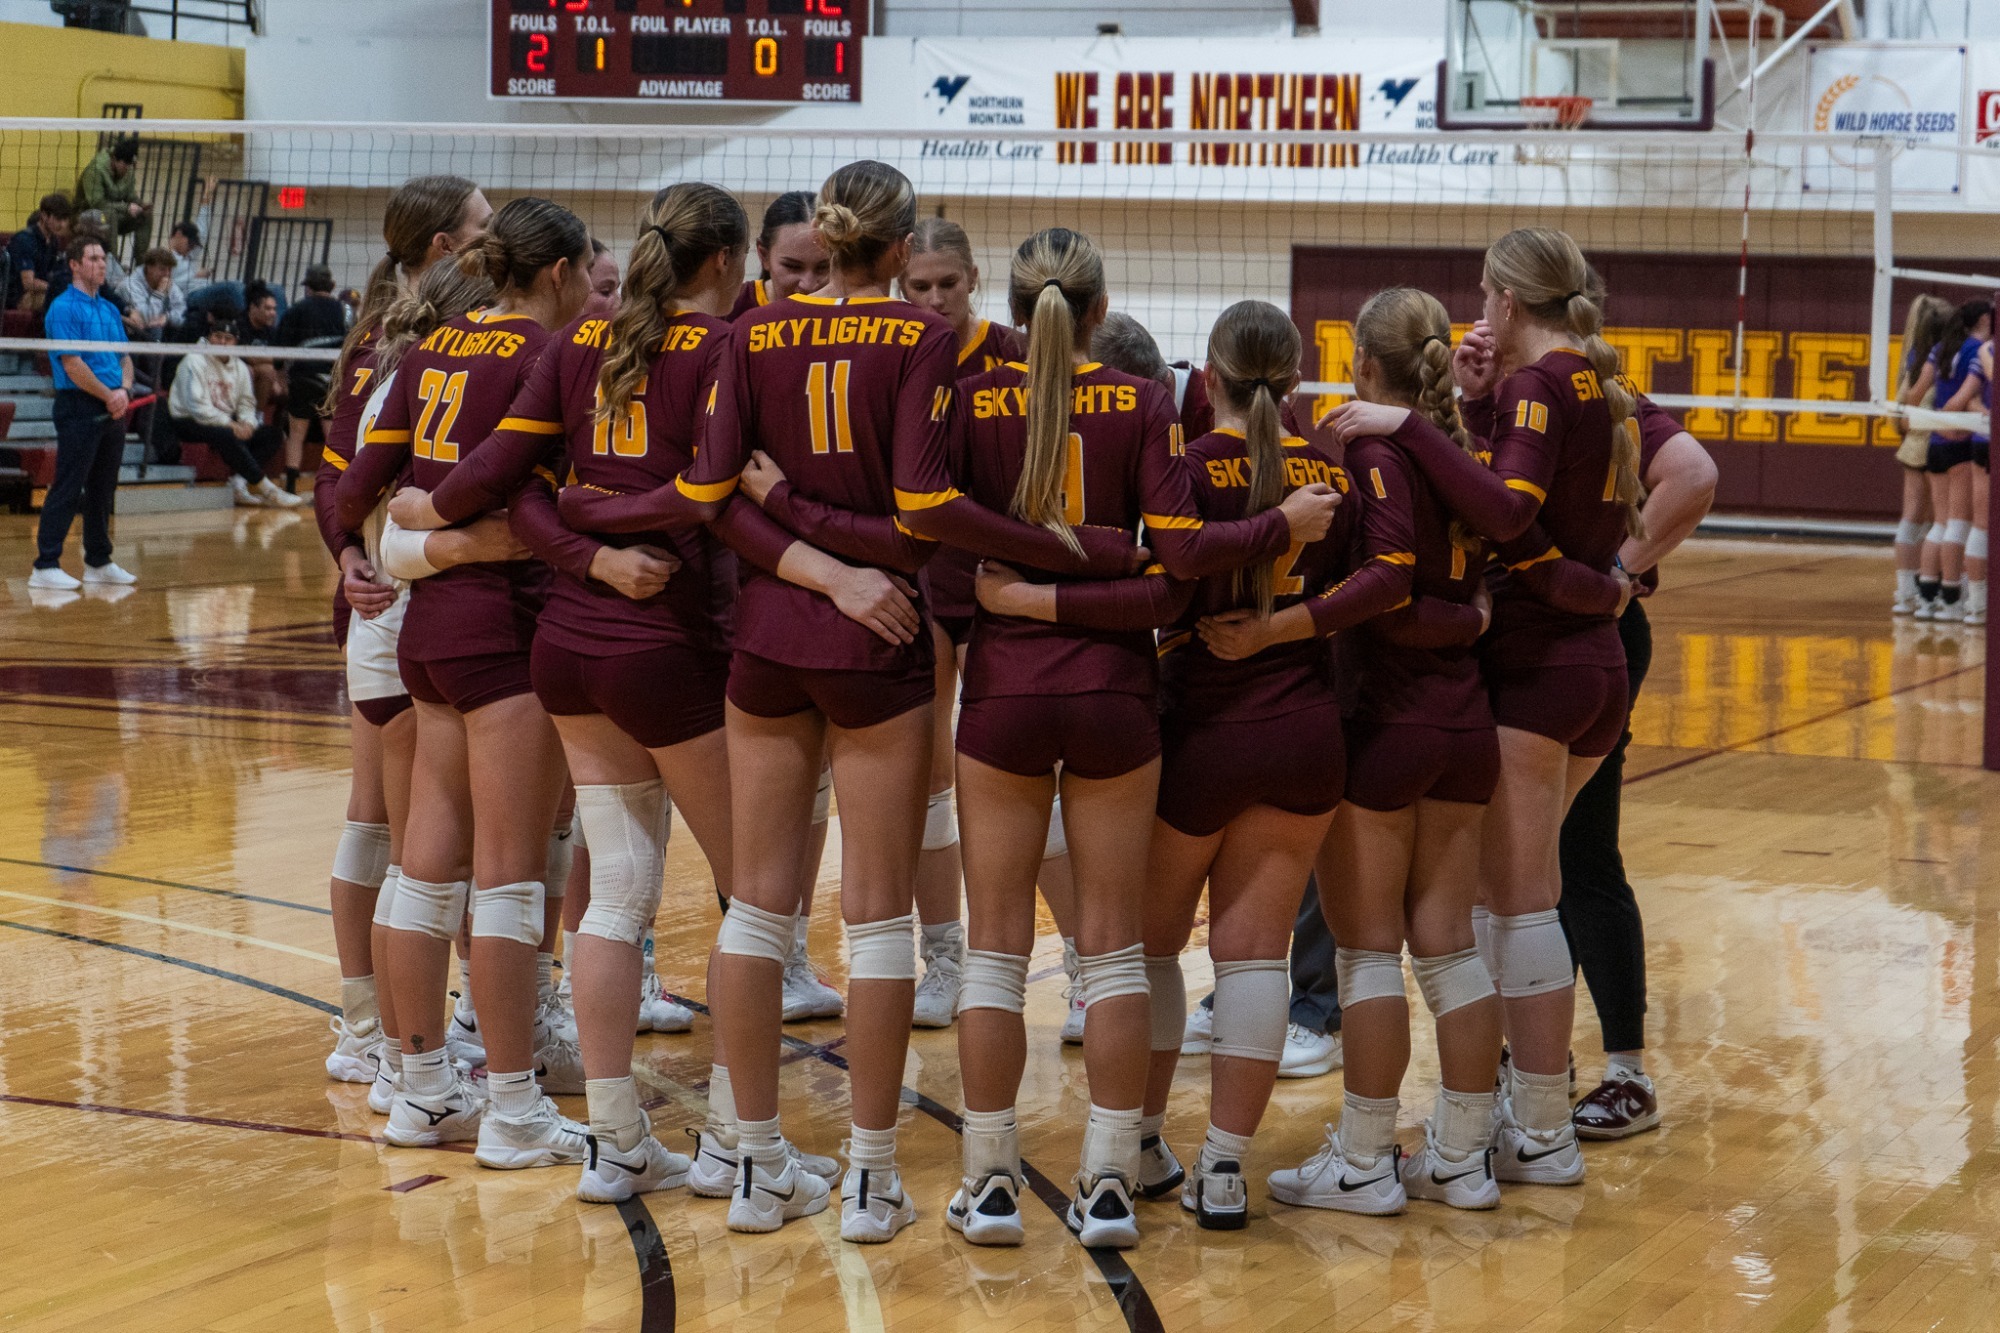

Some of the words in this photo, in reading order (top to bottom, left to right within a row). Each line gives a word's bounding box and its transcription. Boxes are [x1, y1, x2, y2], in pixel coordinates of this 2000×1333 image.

[510, 14, 557, 31] FOULS
[574, 16, 616, 32] T.O.L.
[631, 16, 668, 32] FOUL
[674, 17, 731, 34] PLAYER
[746, 19, 787, 36] T.O.L.
[804, 19, 851, 36] FOULS
[527, 34, 549, 71] 2
[596, 38, 605, 70] 1
[755, 38, 777, 75] 0
[836, 42, 845, 73] 1
[508, 79, 556, 95] SCORE
[638, 80, 723, 97] ADVANTAGE
[802, 83, 851, 100] SCORE
[969, 97, 1024, 109] NORTHERN
[969, 113, 1025, 125] MONTANA
[1055, 72, 1099, 164] WE
[1113, 72, 1174, 164] ARE
[1189, 72, 1361, 167] NORTHERN
[1835, 111, 1867, 131] WILD
[1869, 111, 1911, 132] HORSE
[1915, 111, 1957, 132] SEEDS
[920, 139, 989, 157] Health
[996, 139, 1043, 158] Care
[1366, 144, 1440, 165] Health
[1448, 144, 1499, 165] Care
[749, 316, 926, 352] SKYLIGHTS
[350, 368, 374, 396] 7
[414, 367, 469, 463] 22
[805, 360, 854, 454] 11
[1515, 399, 1549, 434] 10
[1370, 467, 1387, 499] 1
